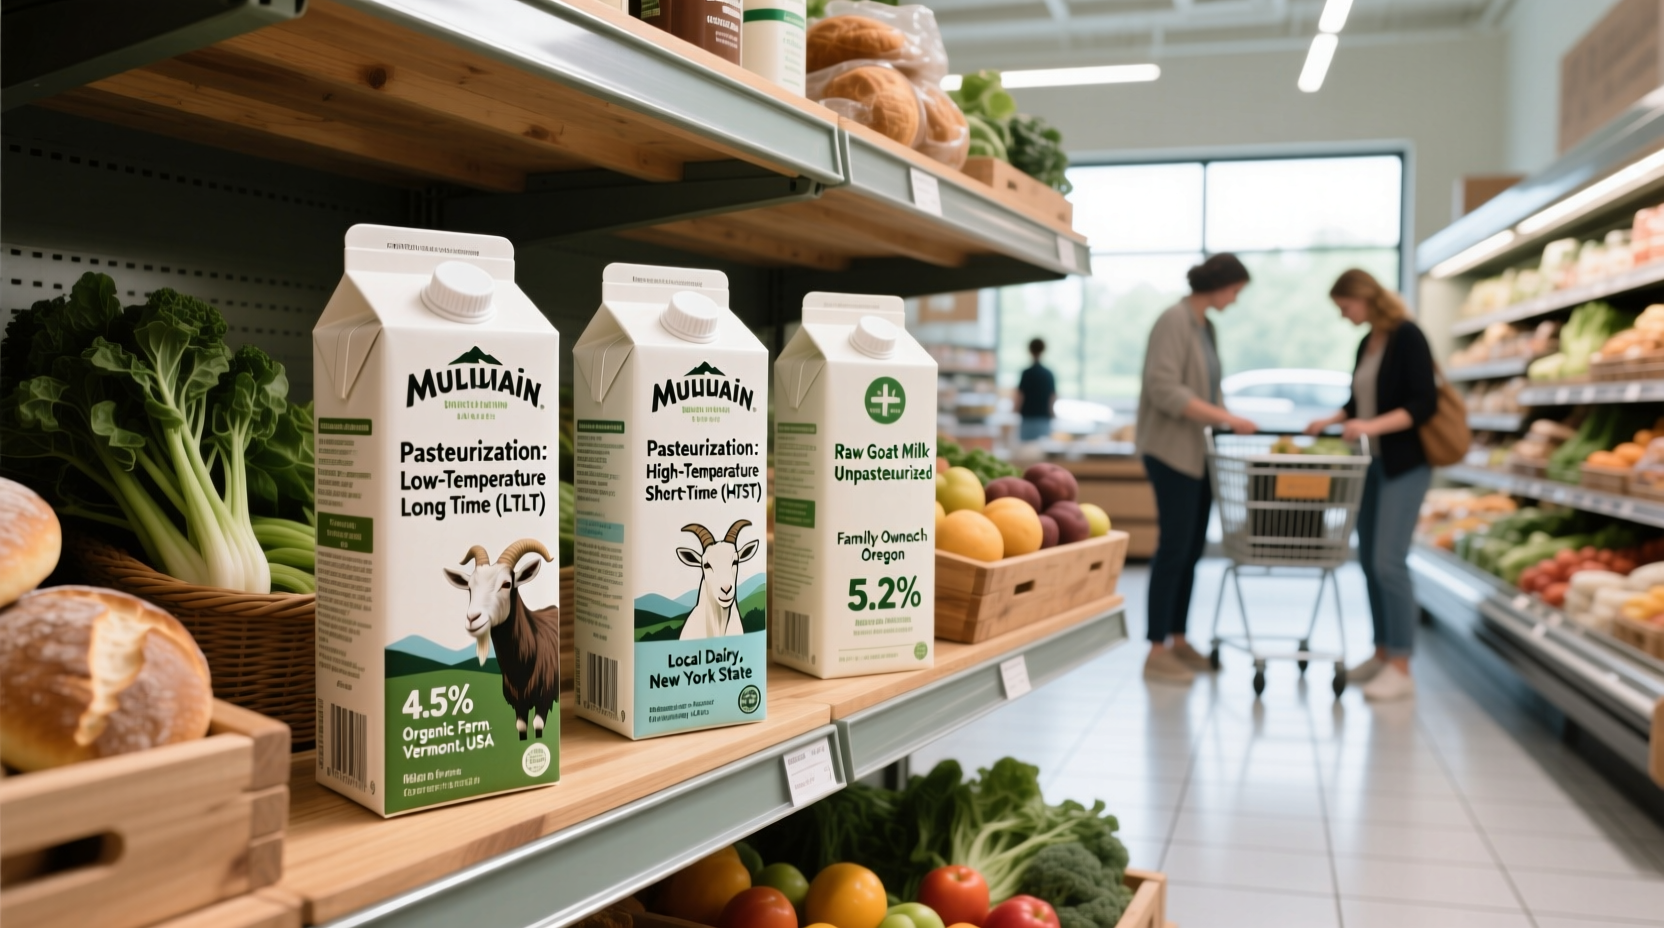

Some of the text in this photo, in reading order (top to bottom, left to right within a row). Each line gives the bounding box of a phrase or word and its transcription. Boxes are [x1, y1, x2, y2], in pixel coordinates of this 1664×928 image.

[400, 439, 547, 463] Pasteurization:
[647, 438, 759, 457] Pasteurization:
[834, 442, 930, 460] Raw Goat Milk
[400, 469, 546, 493] Low-Temperature
[401, 491, 546, 521] Long Time (LTLT)
[861, 547, 905, 565] Oregon
[847, 575, 922, 612] 5.2%
[668, 647, 744, 668] Local Dairy,
[649, 665, 753, 690] New York State
[401, 683, 474, 720] 4.5%
[402, 721, 455, 745] Organic
[466, 732, 495, 751] USA
